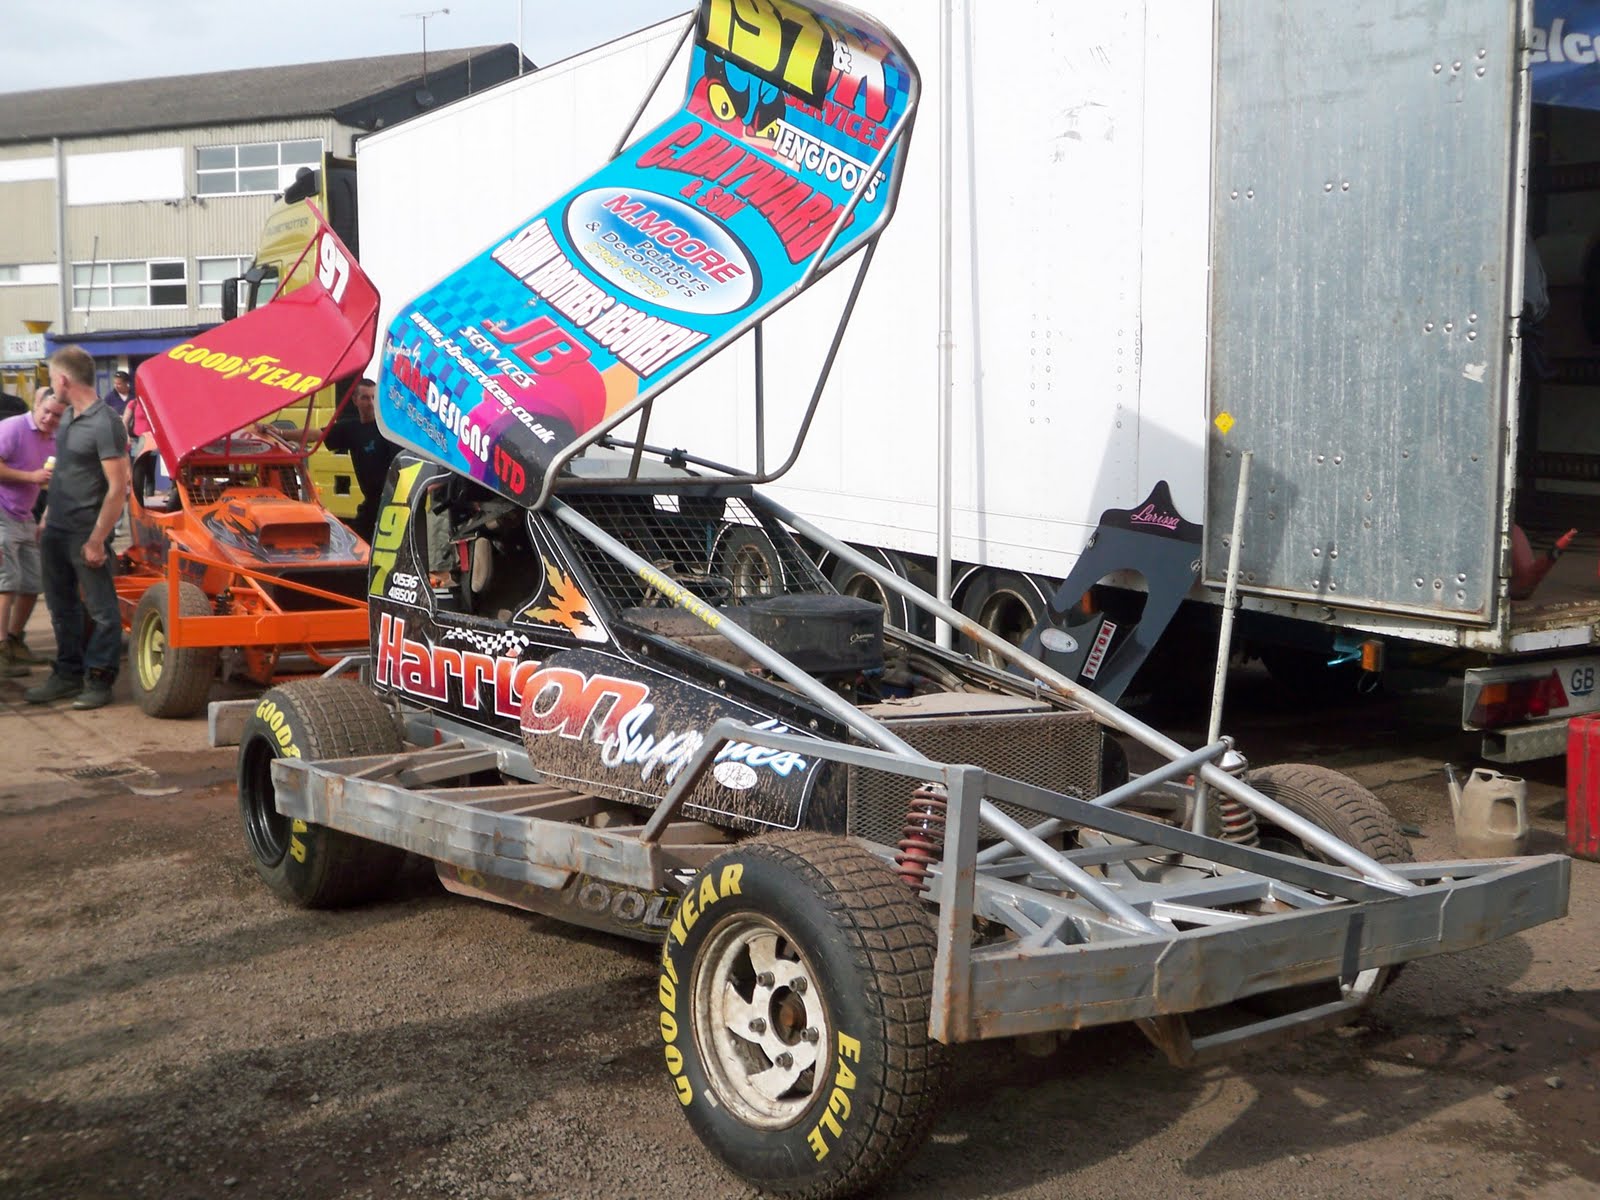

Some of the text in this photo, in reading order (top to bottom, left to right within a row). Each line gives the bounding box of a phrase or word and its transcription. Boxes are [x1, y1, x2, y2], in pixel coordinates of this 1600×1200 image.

[705, 0, 824, 95] 197
[1528, 18, 1600, 64] elc
[696, 186, 749, 222] SON
[585, 221, 697, 298] & Decorators
[601, 192, 746, 285] M.MOORE
[636, 240, 710, 292] Painters
[168, 343, 322, 394] GOODYEAR
[459, 326, 537, 389] SERVICES
[481, 315, 592, 375] JB
[583, 301, 712, 379] RECOVERY
[409, 311, 557, 445] www.j-b-services.co.uk
[493, 444, 526, 495] LTD
[1130, 503, 1181, 529] Larissa
[640, 566, 722, 630] GOODYEAR
[375, 611, 651, 746] Harrison
[1571, 667, 1595, 691] GB
[659, 863, 744, 1106] GOODYEAR
[807, 1030, 862, 1162] EAGLE
